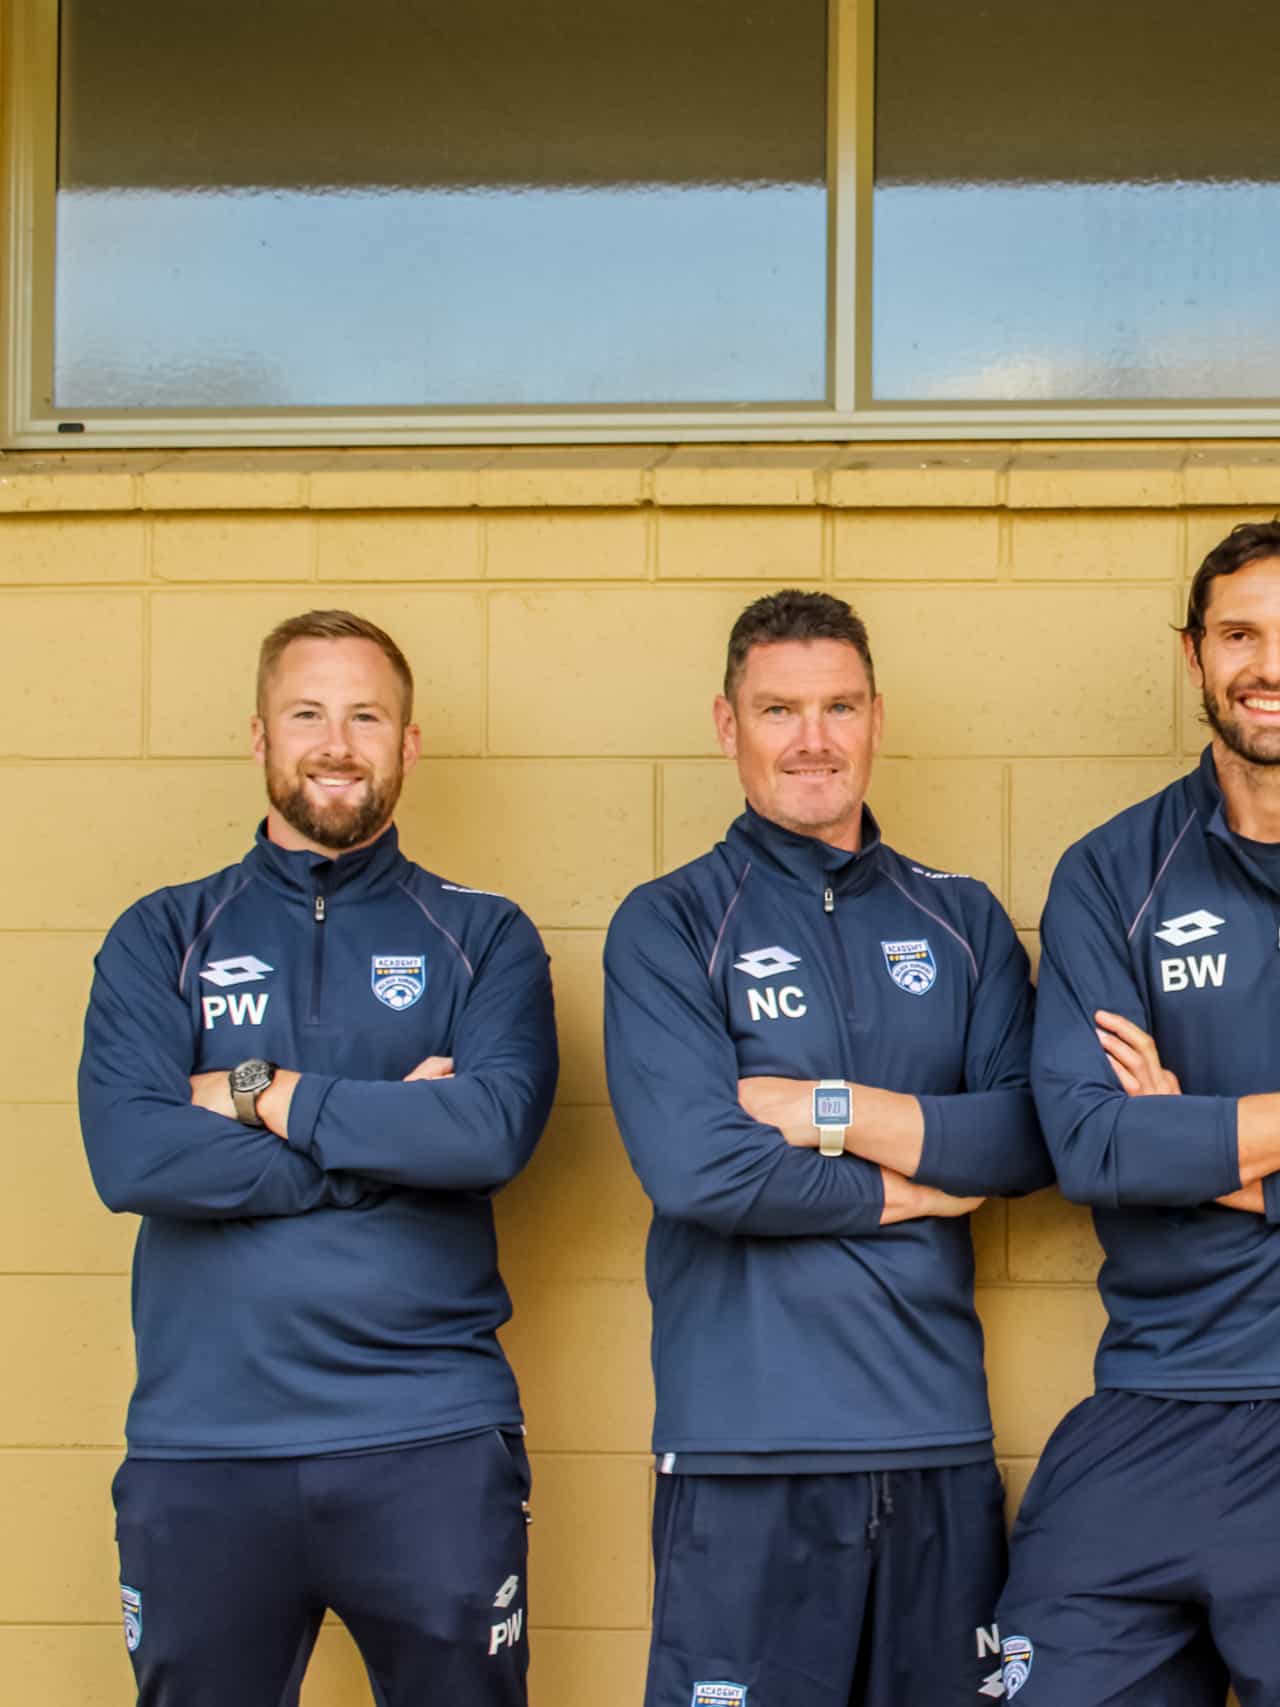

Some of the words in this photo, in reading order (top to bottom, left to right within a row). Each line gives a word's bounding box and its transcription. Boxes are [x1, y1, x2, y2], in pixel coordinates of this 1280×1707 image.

[378, 959, 419, 967] ACADEMY
[1160, 953, 1227, 993] BW
[202, 993, 269, 1030] PW
[747, 985, 807, 1021] NC
[488, 1608, 522, 1656] PW
[976, 1623, 1000, 1658] N
[700, 1687, 740, 1697] ACADEMY
